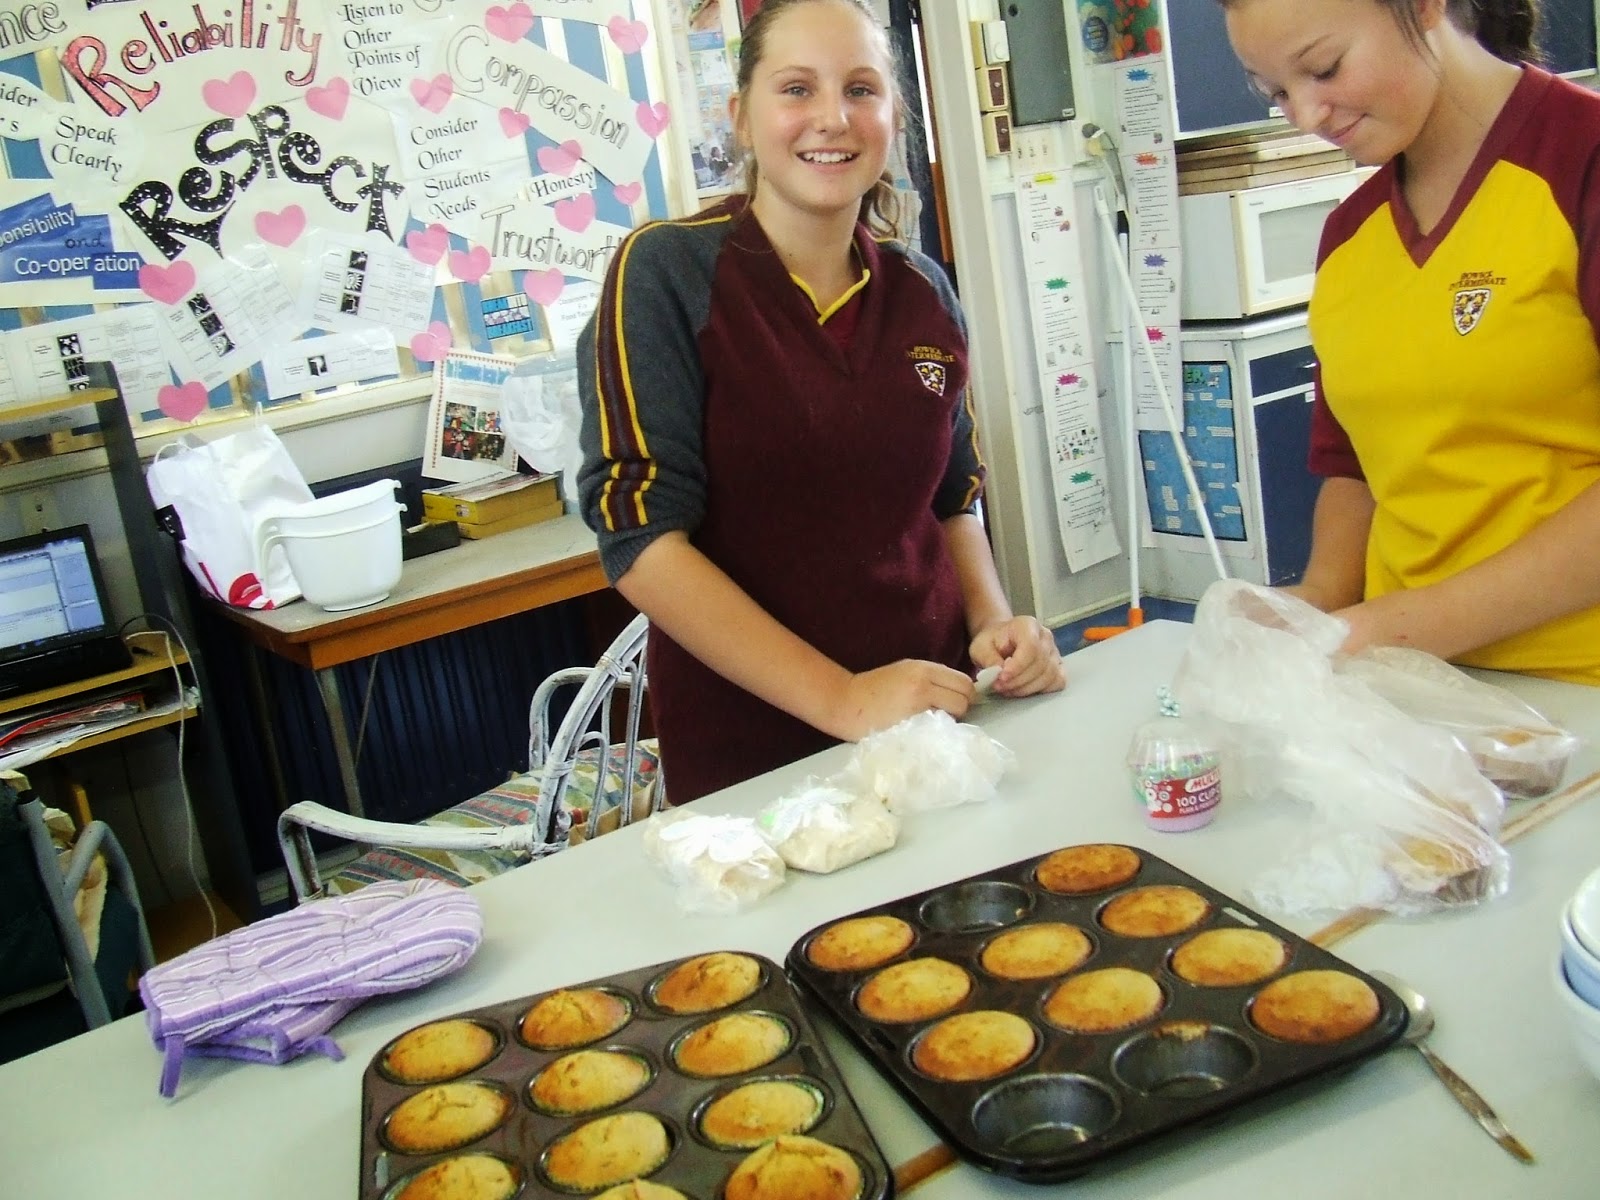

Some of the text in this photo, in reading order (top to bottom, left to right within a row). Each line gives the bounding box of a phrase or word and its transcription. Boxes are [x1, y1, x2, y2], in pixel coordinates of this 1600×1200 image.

[337, 3, 385, 26] Listen
[388, 2, 404, 16] to
[344, 28, 392, 49] Other
[60, 0, 322, 117] Reliability
[349, 45, 421, 73] Points of
[354, 76, 402, 97] View
[446, 25, 629, 149] Compassion
[56, 115, 118, 145] Speak
[411, 117, 478, 146] Consider
[51, 143, 122, 182] Clearly
[418, 146, 463, 170] Other
[424, 166, 491, 200] Students
[530, 170, 595, 198] Honesty
[429, 196, 478, 221] Needs
[0, 209, 75, 248] onsibility
[481, 203, 622, 276] Trustwort
[1175, 795, 1197, 808] 100
